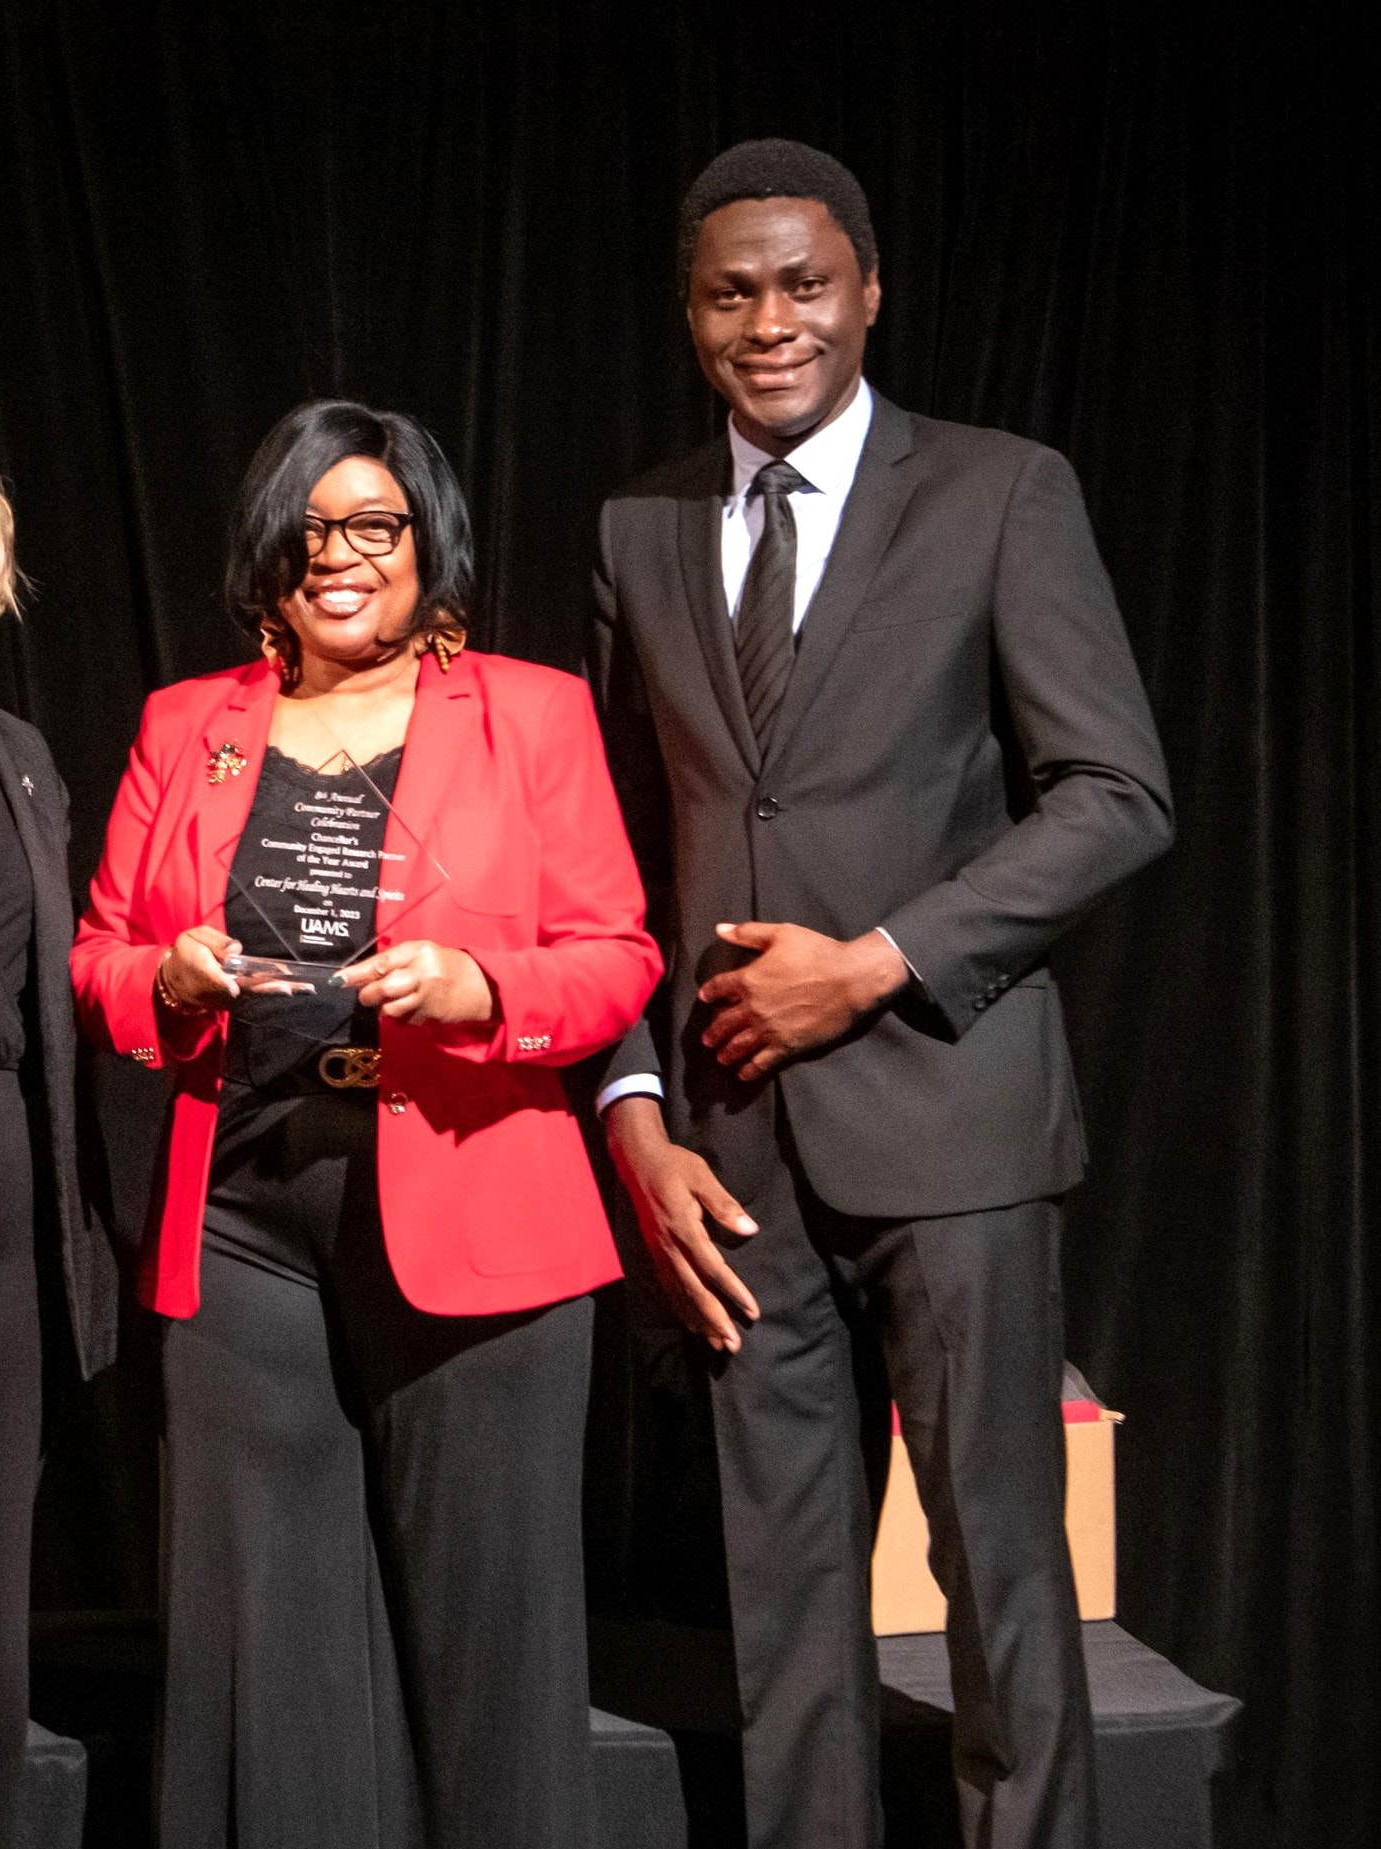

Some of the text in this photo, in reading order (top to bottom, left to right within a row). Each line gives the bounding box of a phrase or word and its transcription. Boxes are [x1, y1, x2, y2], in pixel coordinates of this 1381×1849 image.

[295, 802, 344, 818] Community
[261, 838, 307, 852] Community
[296, 854, 307, 863] of
[307, 854, 321, 864] the
[322, 855, 340, 866] Year
[279, 877, 297, 892] for
[294, 904, 329, 916] December
